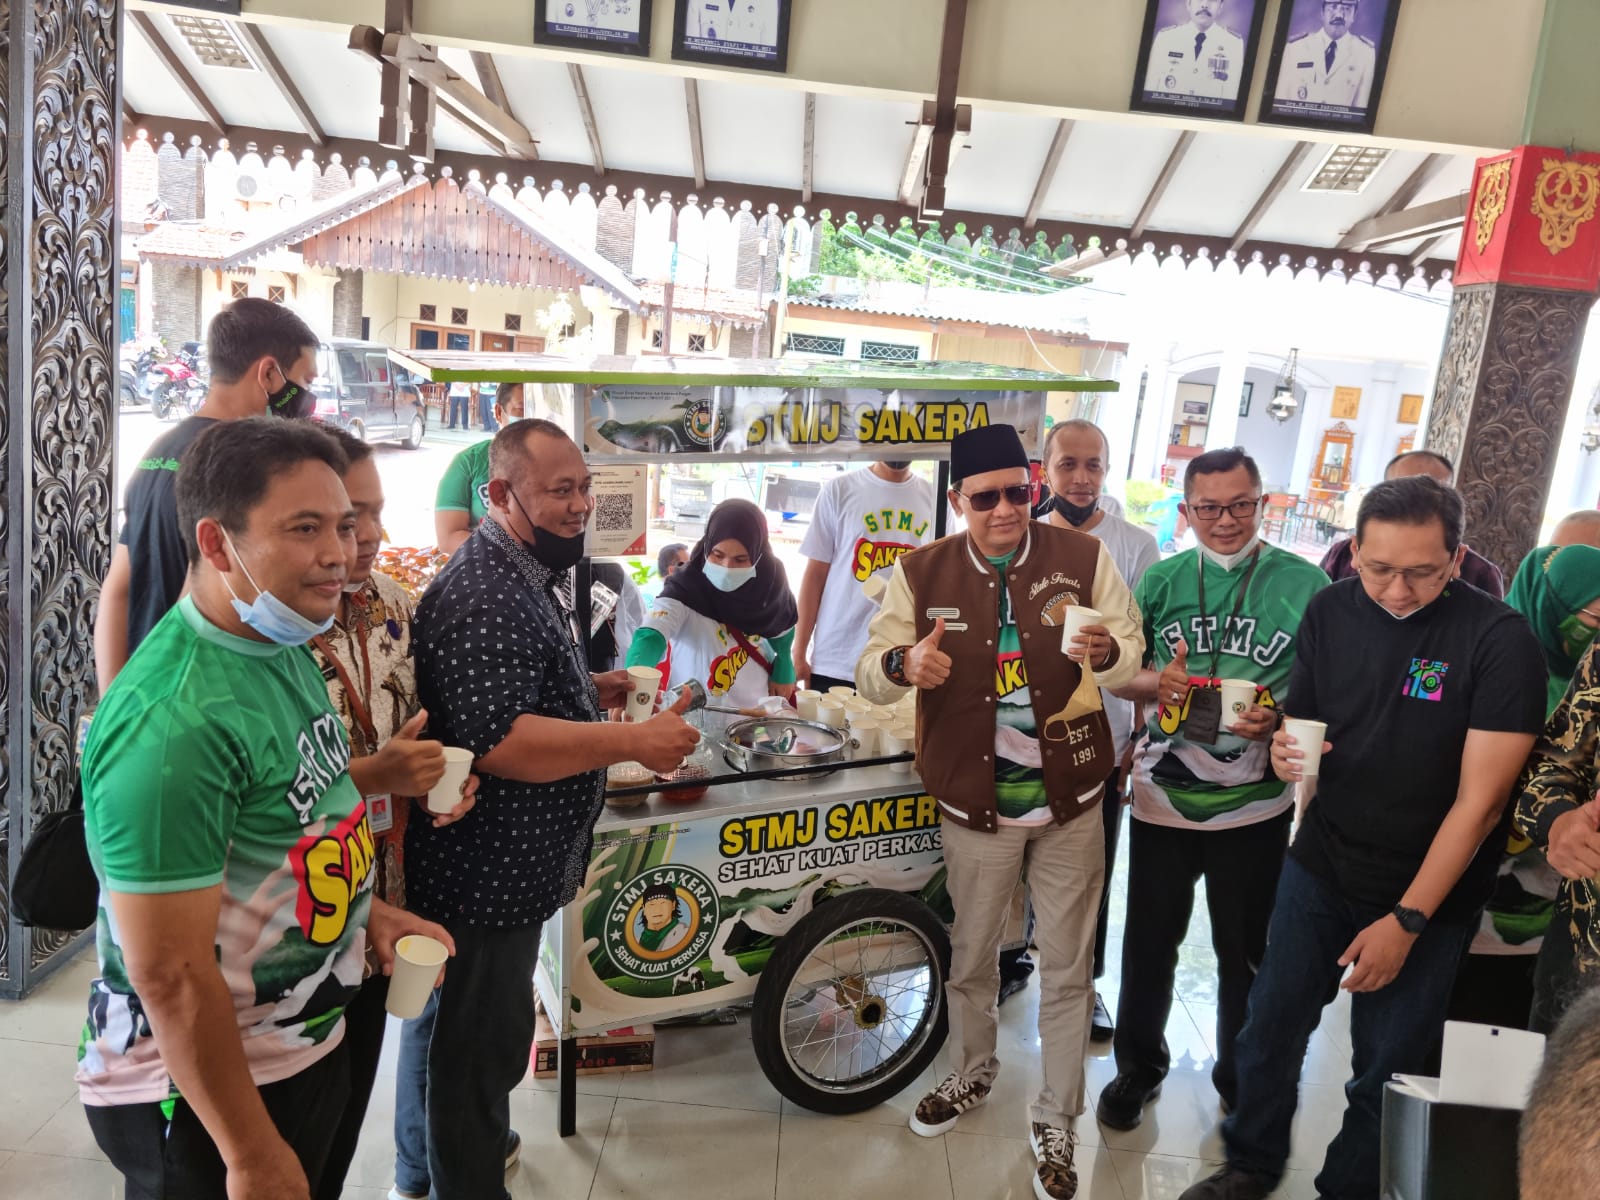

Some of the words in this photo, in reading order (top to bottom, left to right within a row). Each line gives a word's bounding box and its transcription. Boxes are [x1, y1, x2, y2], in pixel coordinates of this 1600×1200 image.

[745, 402, 842, 443] STMJ
[855, 402, 990, 443] SAKERA
[864, 510, 929, 537] STMJ
[1050, 572, 1081, 589] Finals
[1160, 615, 1293, 667] STMJ
[1069, 724, 1093, 745] EST.
[1072, 745, 1096, 766] 1991
[287, 713, 351, 826] STM
[720, 810, 817, 857] STMJ
[825, 794, 942, 841] SAKER
[718, 852, 795, 883] SEHAT
[798, 842, 859, 871] KUAT
[863, 830, 943, 861] PERKAS
[612, 879, 648, 922] STMJ
[653, 870, 712, 909] SAKERA
[614, 945, 641, 970] SEHAT
[639, 961, 670, 974] KUAT
[670, 930, 710, 968] PERKASA
